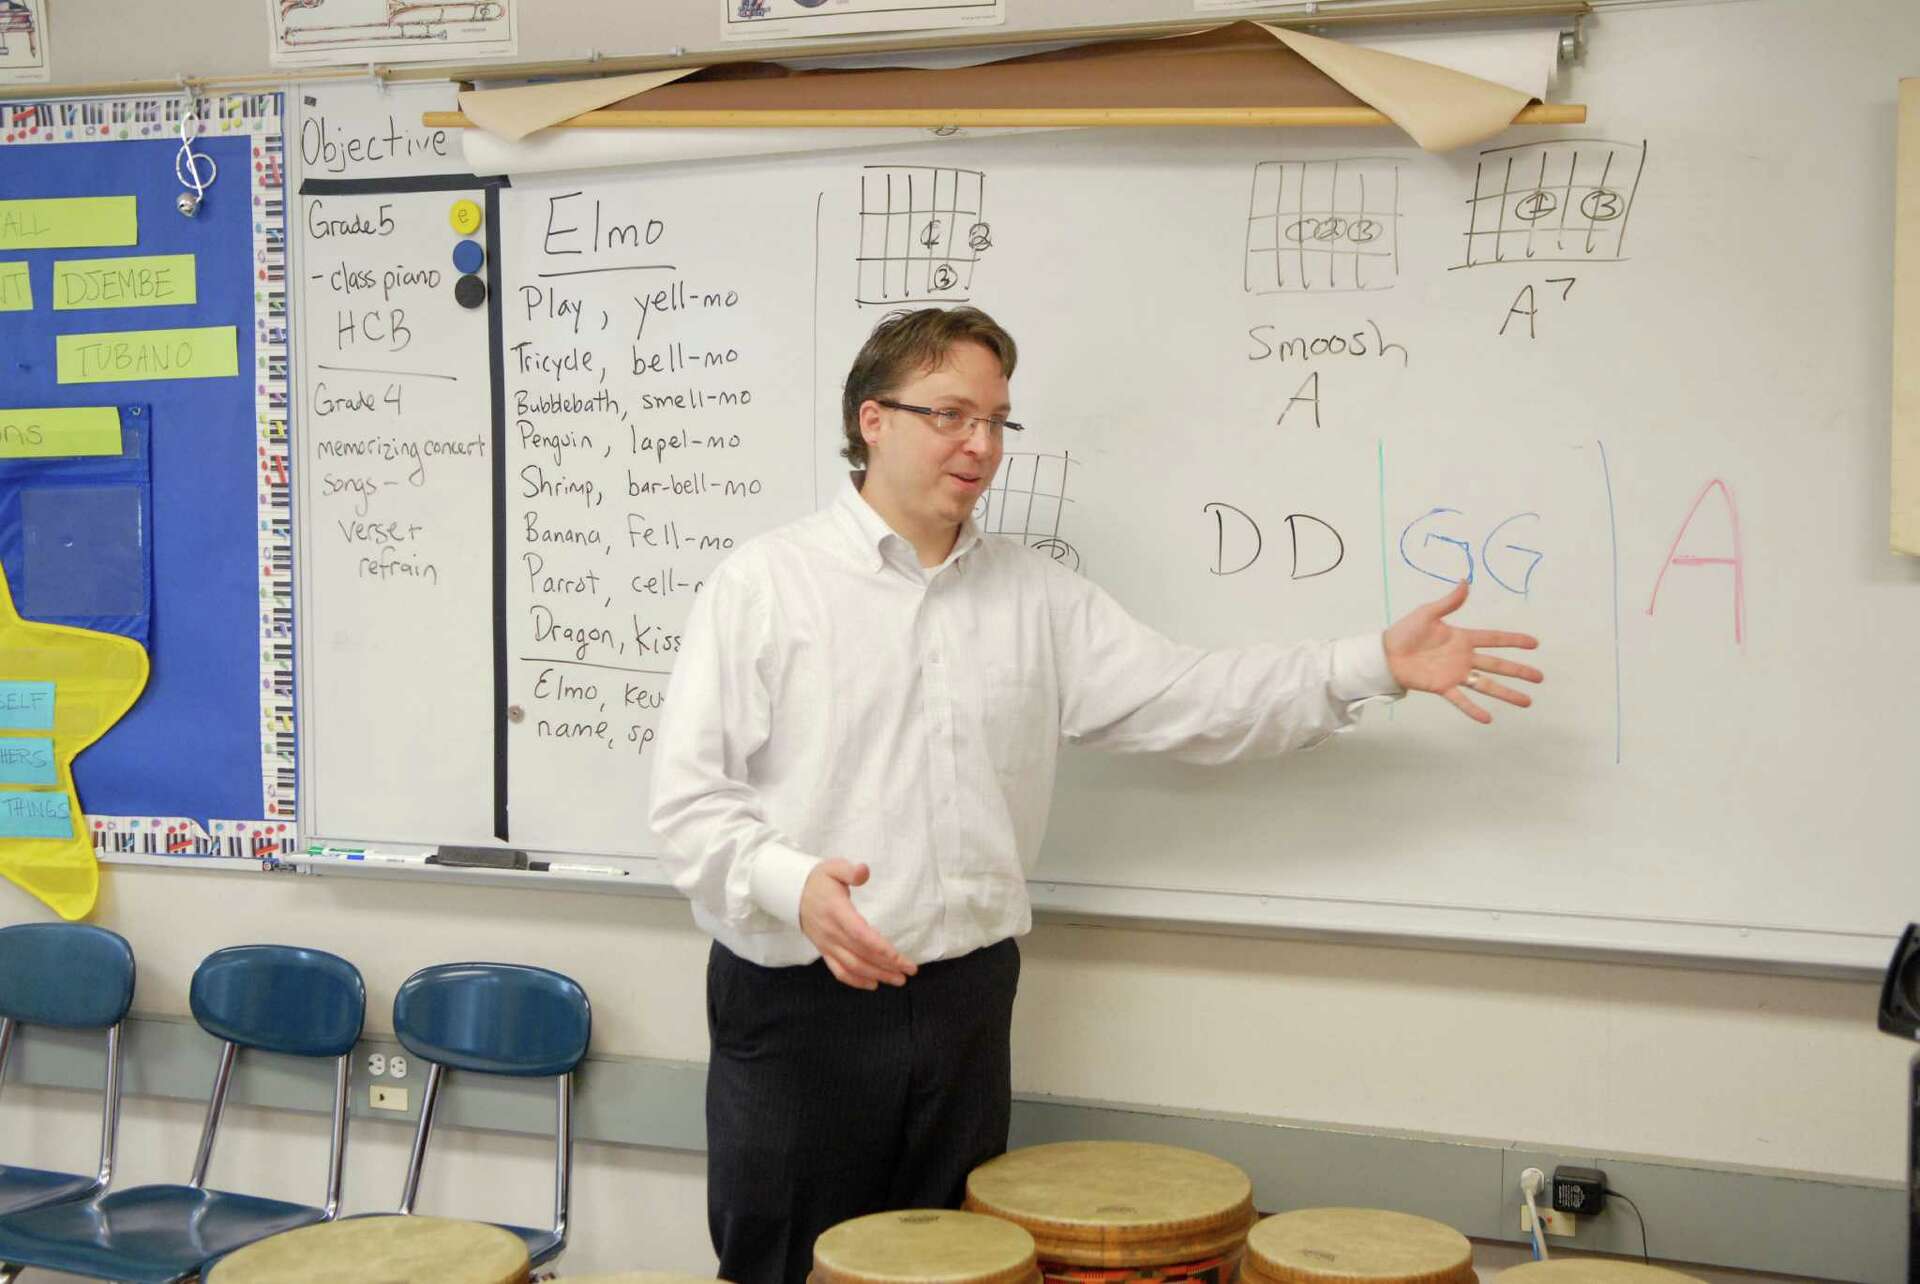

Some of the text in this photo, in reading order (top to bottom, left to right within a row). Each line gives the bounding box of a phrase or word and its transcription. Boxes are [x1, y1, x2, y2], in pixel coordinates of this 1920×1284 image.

[301, 115, 447, 173] Objective
[308, 199, 395, 239] Grade 5
[544, 191, 664, 255] Elmo
[61, 268, 175, 305] DJEMBE
[383, 265, 441, 302] piano
[633, 280, 739, 340] yell-mo
[75, 341, 193, 377] TUBANO
[509, 341, 739, 384] Tricycle, bell-mo
[1248, 320, 1409, 368] Smoosh
[313, 381, 402, 416] Grade 4
[641, 388, 752, 410] smell-mo
[1276, 371, 1321, 428] A
[317, 433, 487, 488] memorizing concert
[515, 418, 742, 467] Penguin, lapel-mo
[519, 464, 763, 508] Shrimp, bar-bell-mo
[522, 510, 611, 556] Banana,
[358, 545, 438, 586] refrain
[522, 551, 611, 608] Parrot,
[1645, 476, 1746, 648] A
[529, 604, 624, 661] Dragon,
[533, 667, 606, 713] Elmo,
[537, 719, 614, 750] name,
